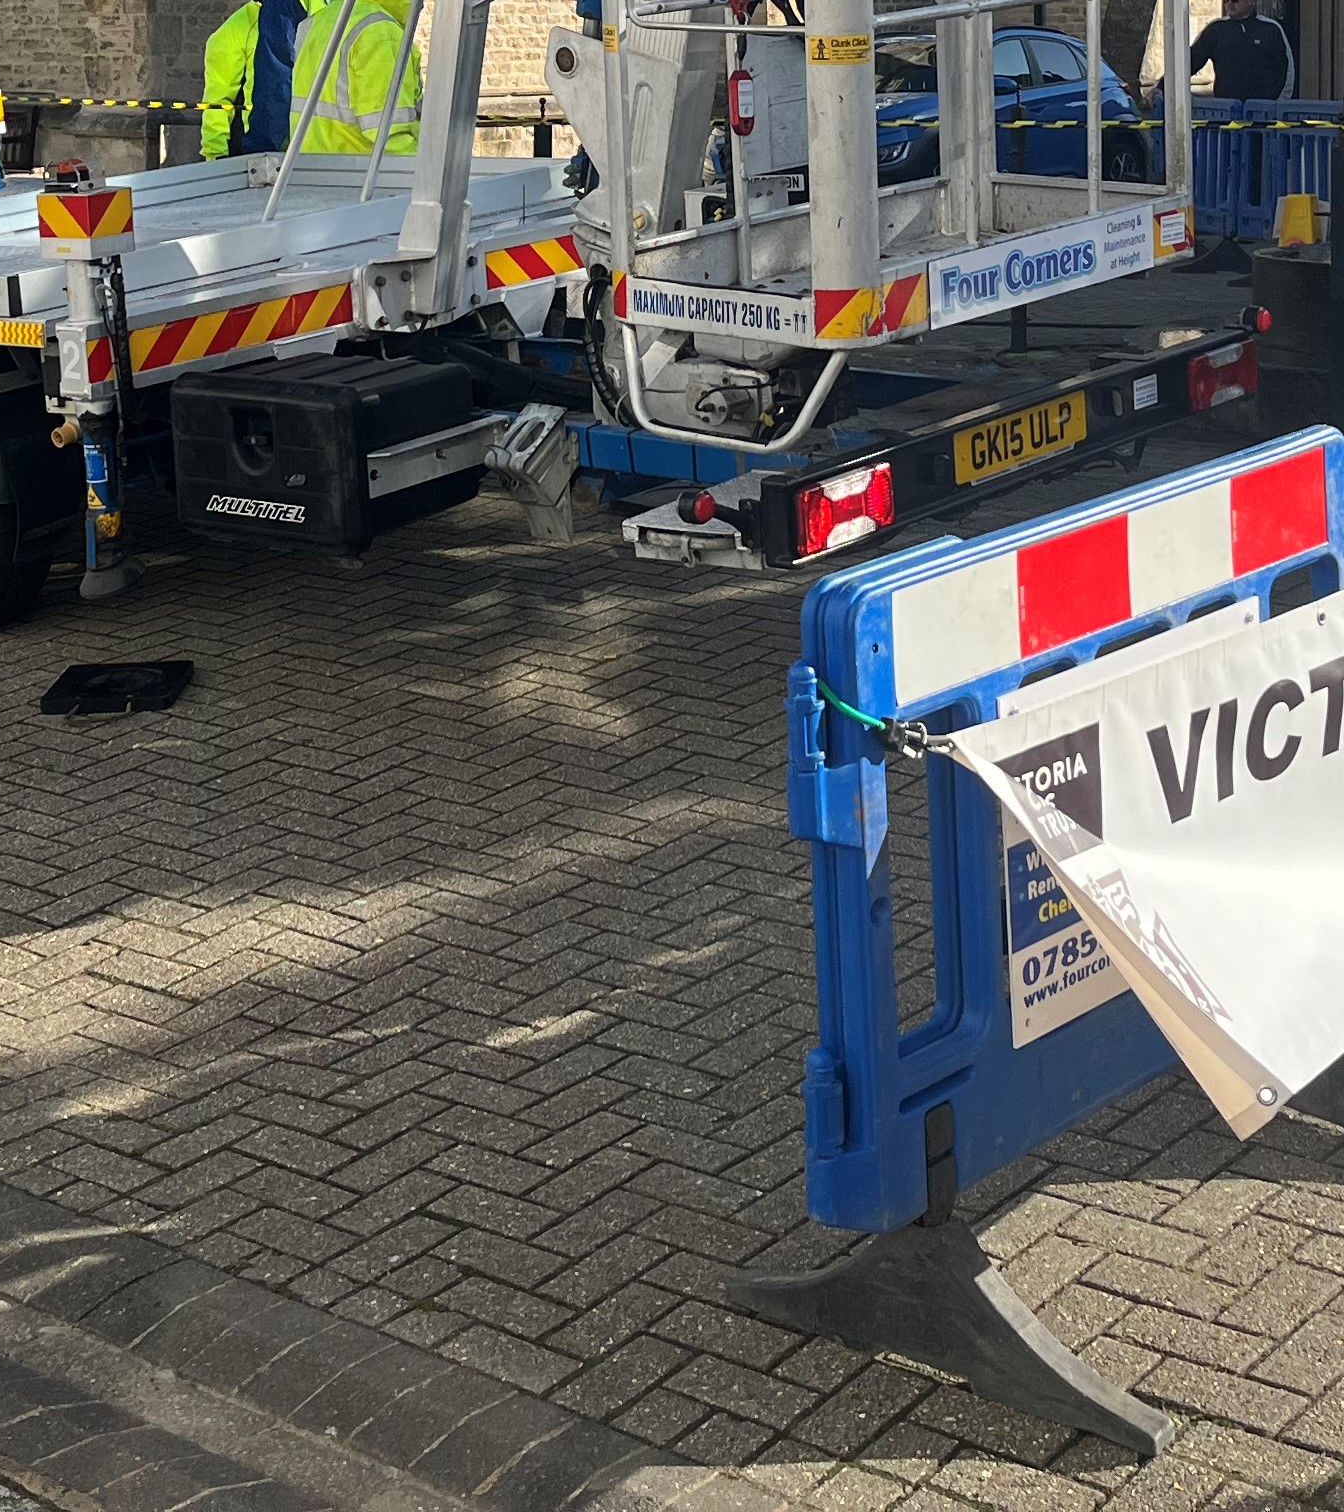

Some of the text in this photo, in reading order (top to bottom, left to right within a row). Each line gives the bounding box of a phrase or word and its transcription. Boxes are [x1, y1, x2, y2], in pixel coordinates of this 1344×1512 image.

[1104, 233, 1145, 254] Maintenance
[1106, 217, 1135, 234] Cleaning
[941, 240, 1096, 312] Four Corners
[1110, 250, 1141, 270] at Height
[634, 289, 685, 319] MAXIMUM
[688, 296, 738, 325] CAPACITY
[741, 303, 762, 329] 250
[766, 307, 780, 331] KG
[63, 340, 82, 380] 2
[971, 401, 1072, 470] GK15 ULP
[206, 494, 306, 524] MULTITEL
[1014, 752, 1088, 792] TORIA
[1022, 929, 1102, 986] 0785
